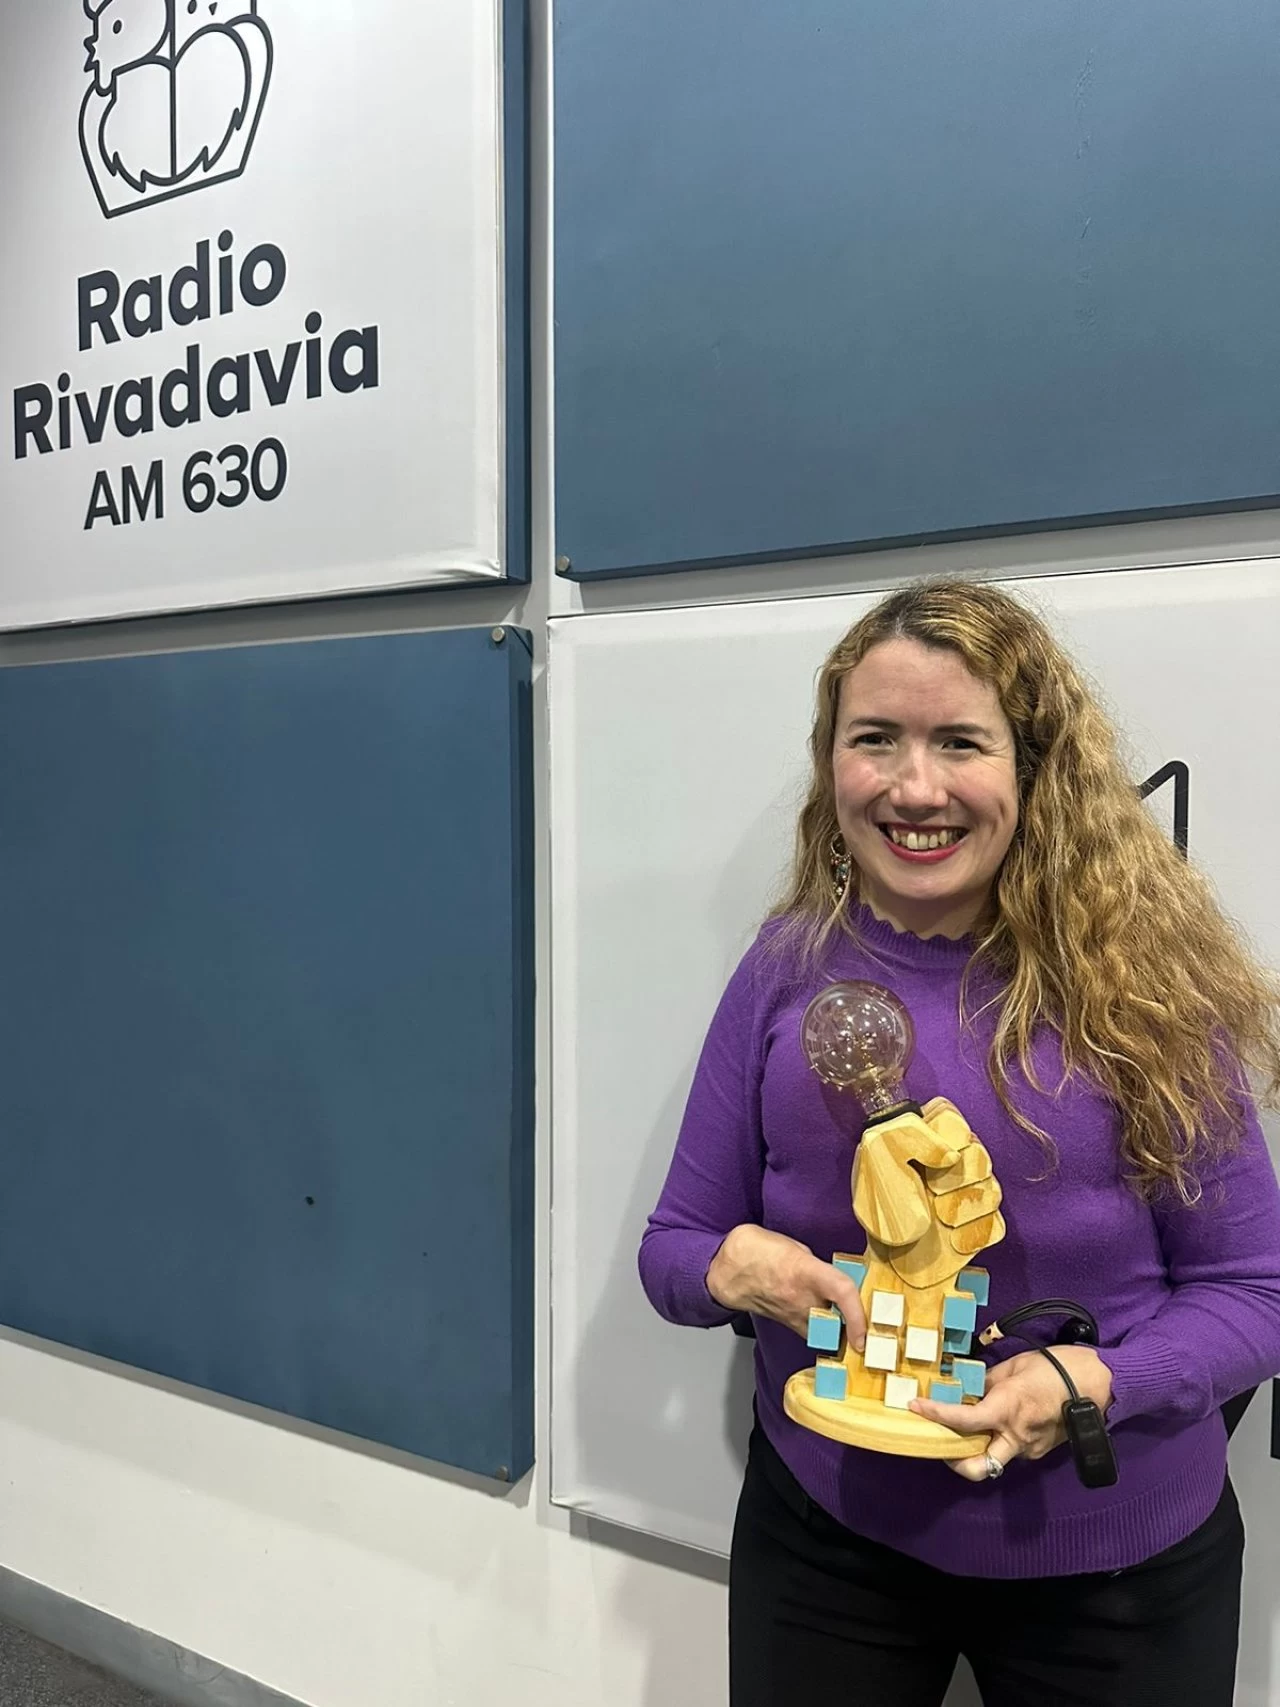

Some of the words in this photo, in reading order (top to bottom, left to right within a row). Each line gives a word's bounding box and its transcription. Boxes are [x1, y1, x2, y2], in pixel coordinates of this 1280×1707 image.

[77, 229, 288, 352] Radio
[13, 311, 380, 460] Rivadavia
[83, 459, 165, 531] AM
[182, 437, 288, 514] 630
